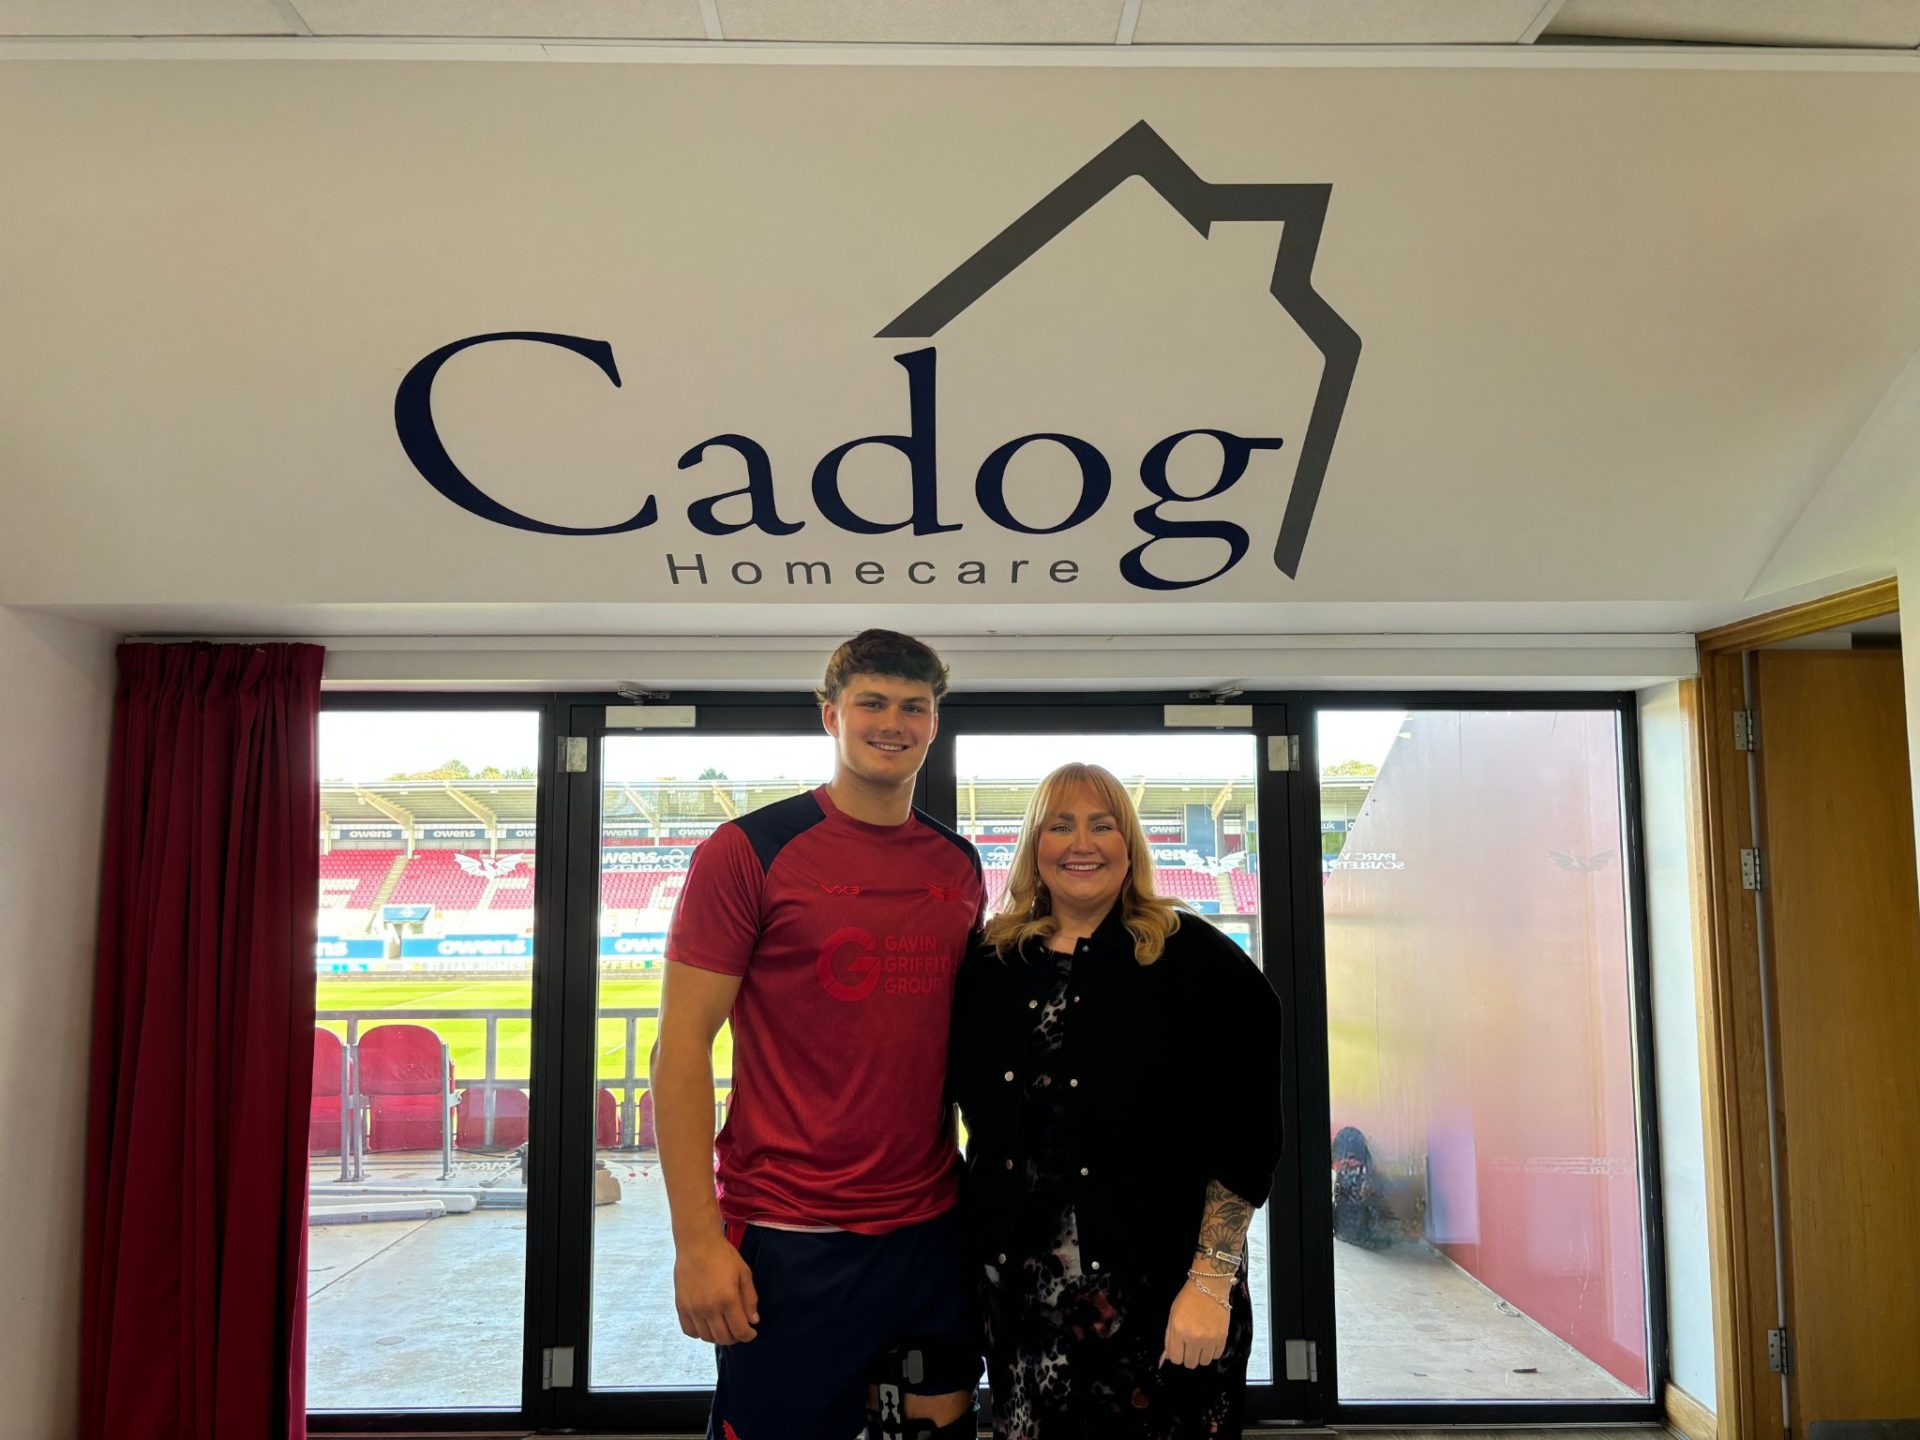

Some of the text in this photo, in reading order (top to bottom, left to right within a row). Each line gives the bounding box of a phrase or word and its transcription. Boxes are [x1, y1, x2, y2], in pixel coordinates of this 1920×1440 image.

[395, 331, 1283, 591] Cadog
[666, 554, 1080, 586] Homecare
[348, 829, 393, 838] owens
[433, 829, 476, 838] owens
[884, 935, 937, 951] GAVIN
[883, 977, 942, 994] GROUP
